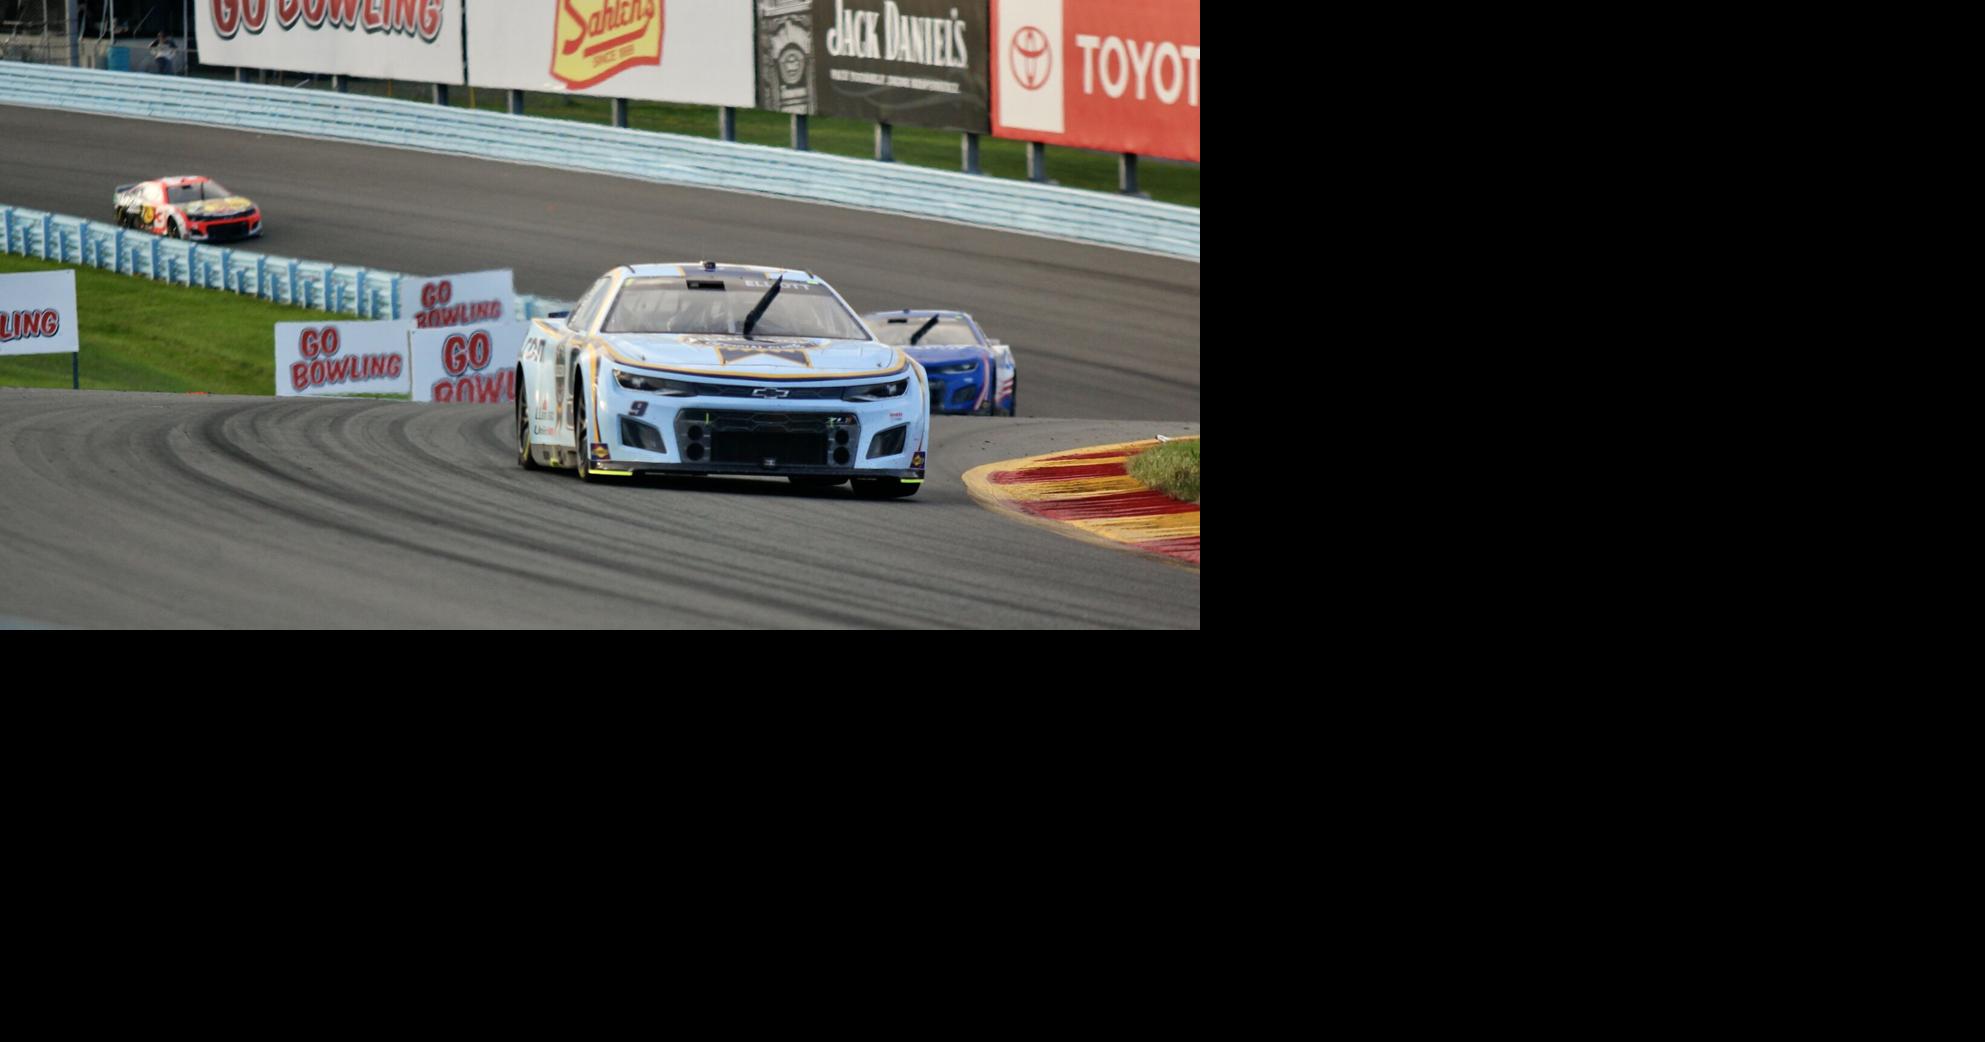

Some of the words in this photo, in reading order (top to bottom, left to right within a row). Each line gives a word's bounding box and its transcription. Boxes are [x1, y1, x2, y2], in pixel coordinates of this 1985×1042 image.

[210, 0, 268, 40] GO
[275, 0, 442, 43] BOWLING
[826, 0, 881, 59] JACK
[884, 0, 969, 68] DANIEL'S
[1075, 34, 1200, 107] TOYOT
[421, 280, 453, 309] GO
[744, 280, 810, 290] ELLOTT
[414, 299, 502, 329] BOWLING
[299, 325, 341, 360] GO
[441, 329, 492, 377] GO
[289, 351, 403, 392] BOWLING
[628, 400, 649, 417] 9
